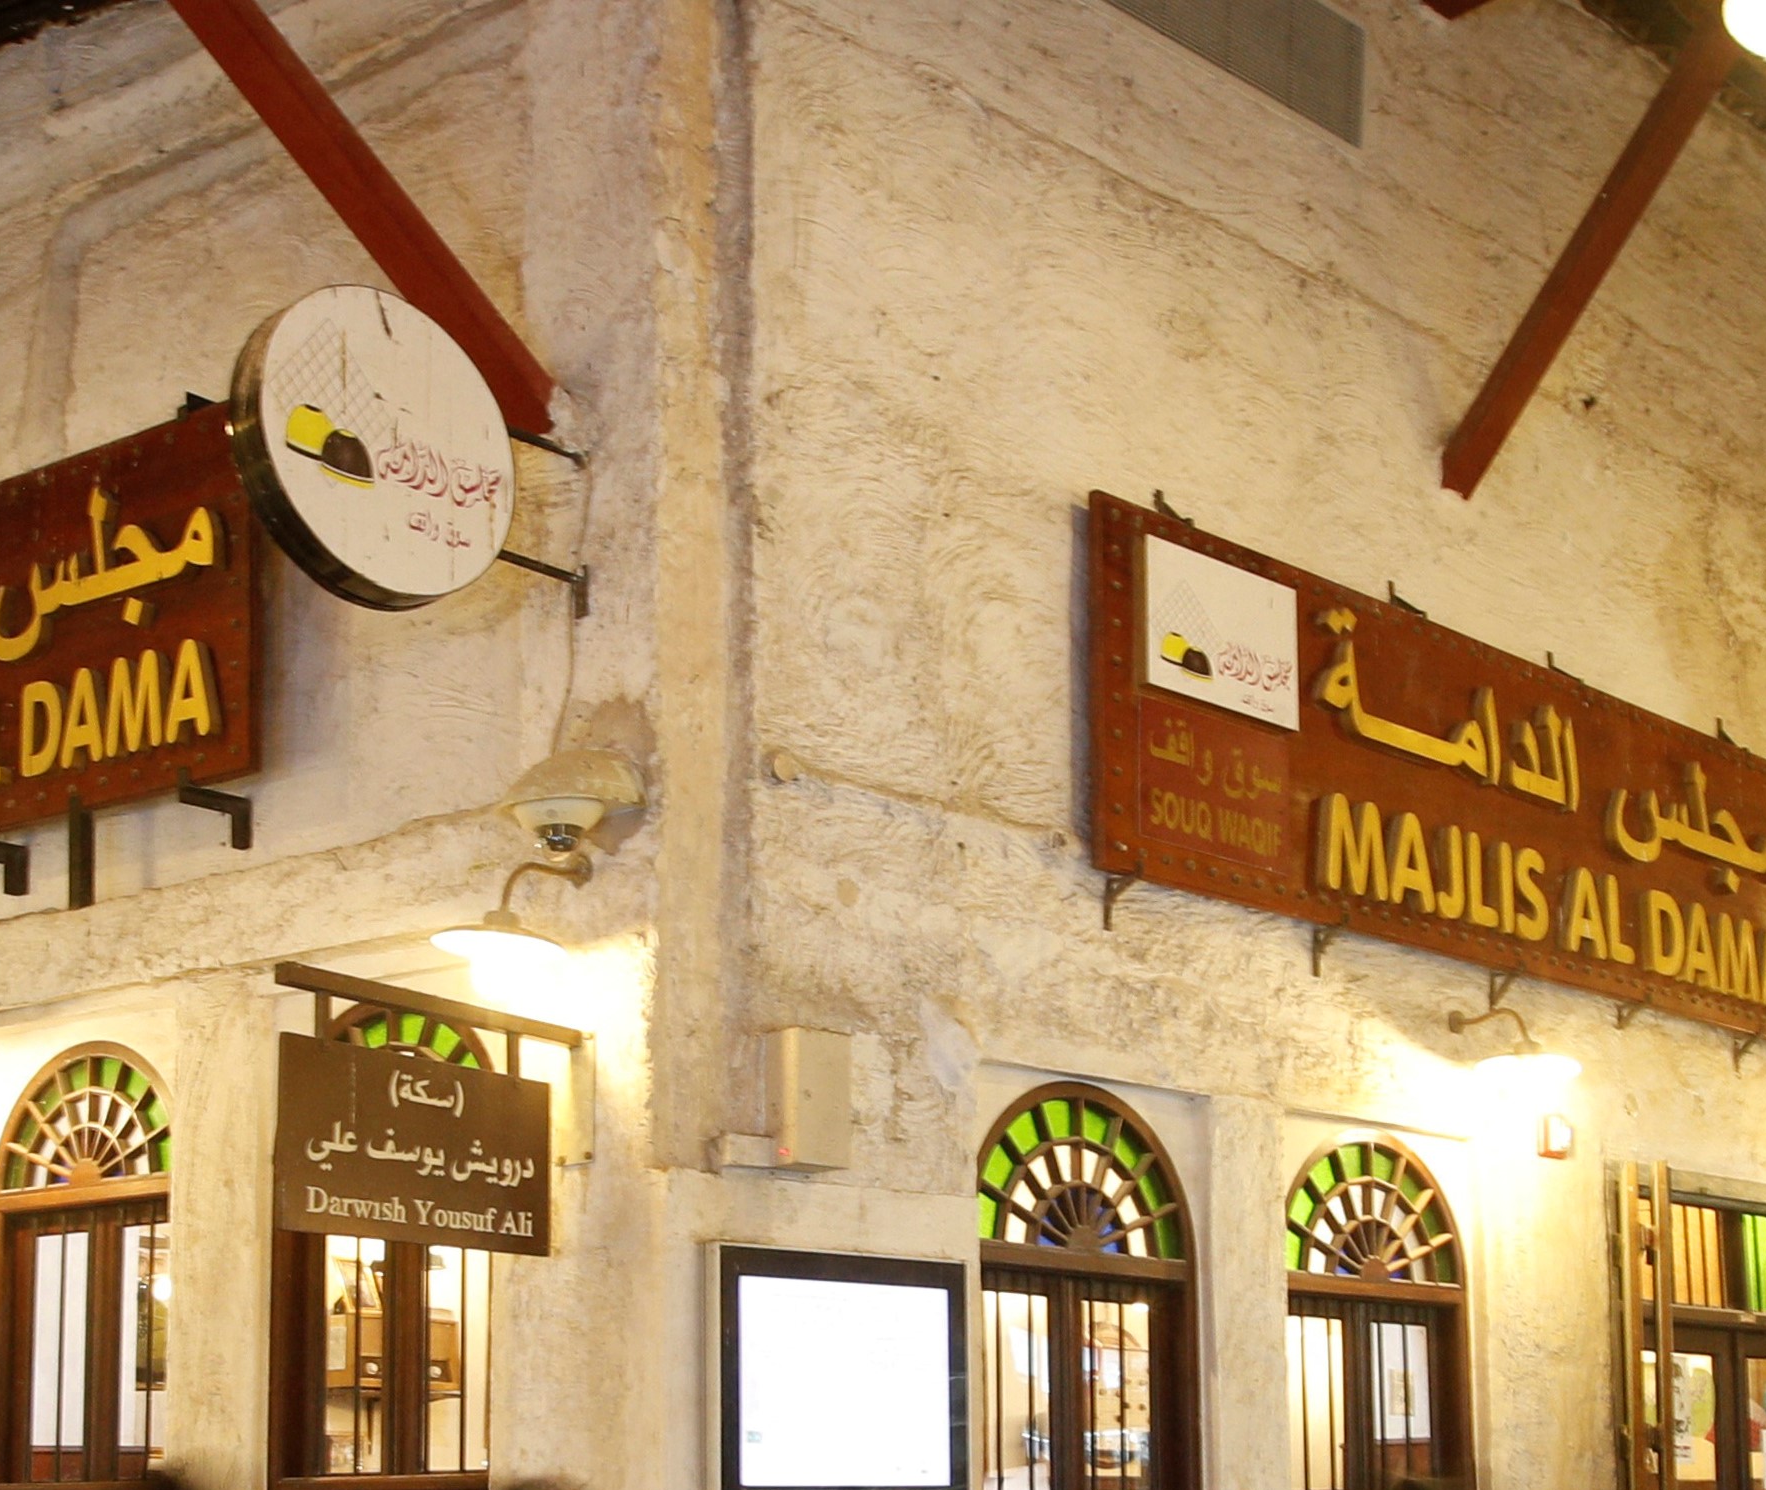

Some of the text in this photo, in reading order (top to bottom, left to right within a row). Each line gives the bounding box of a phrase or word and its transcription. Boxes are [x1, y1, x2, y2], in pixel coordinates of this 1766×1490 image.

[19, 638, 218, 777] DAMA
[1314, 608, 1579, 812] الدامة
[1149, 718, 1282, 799] سوق واقف
[1150, 787, 1282, 858] SOUQ WAQIF
[1321, 792, 1550, 942] MAJLIS
[1562, 865, 1636, 965] AL
[306, 1121, 535, 1187] درويش يوسف علي
[306, 1186, 534, 1237] Darwish Yousuf Ali
